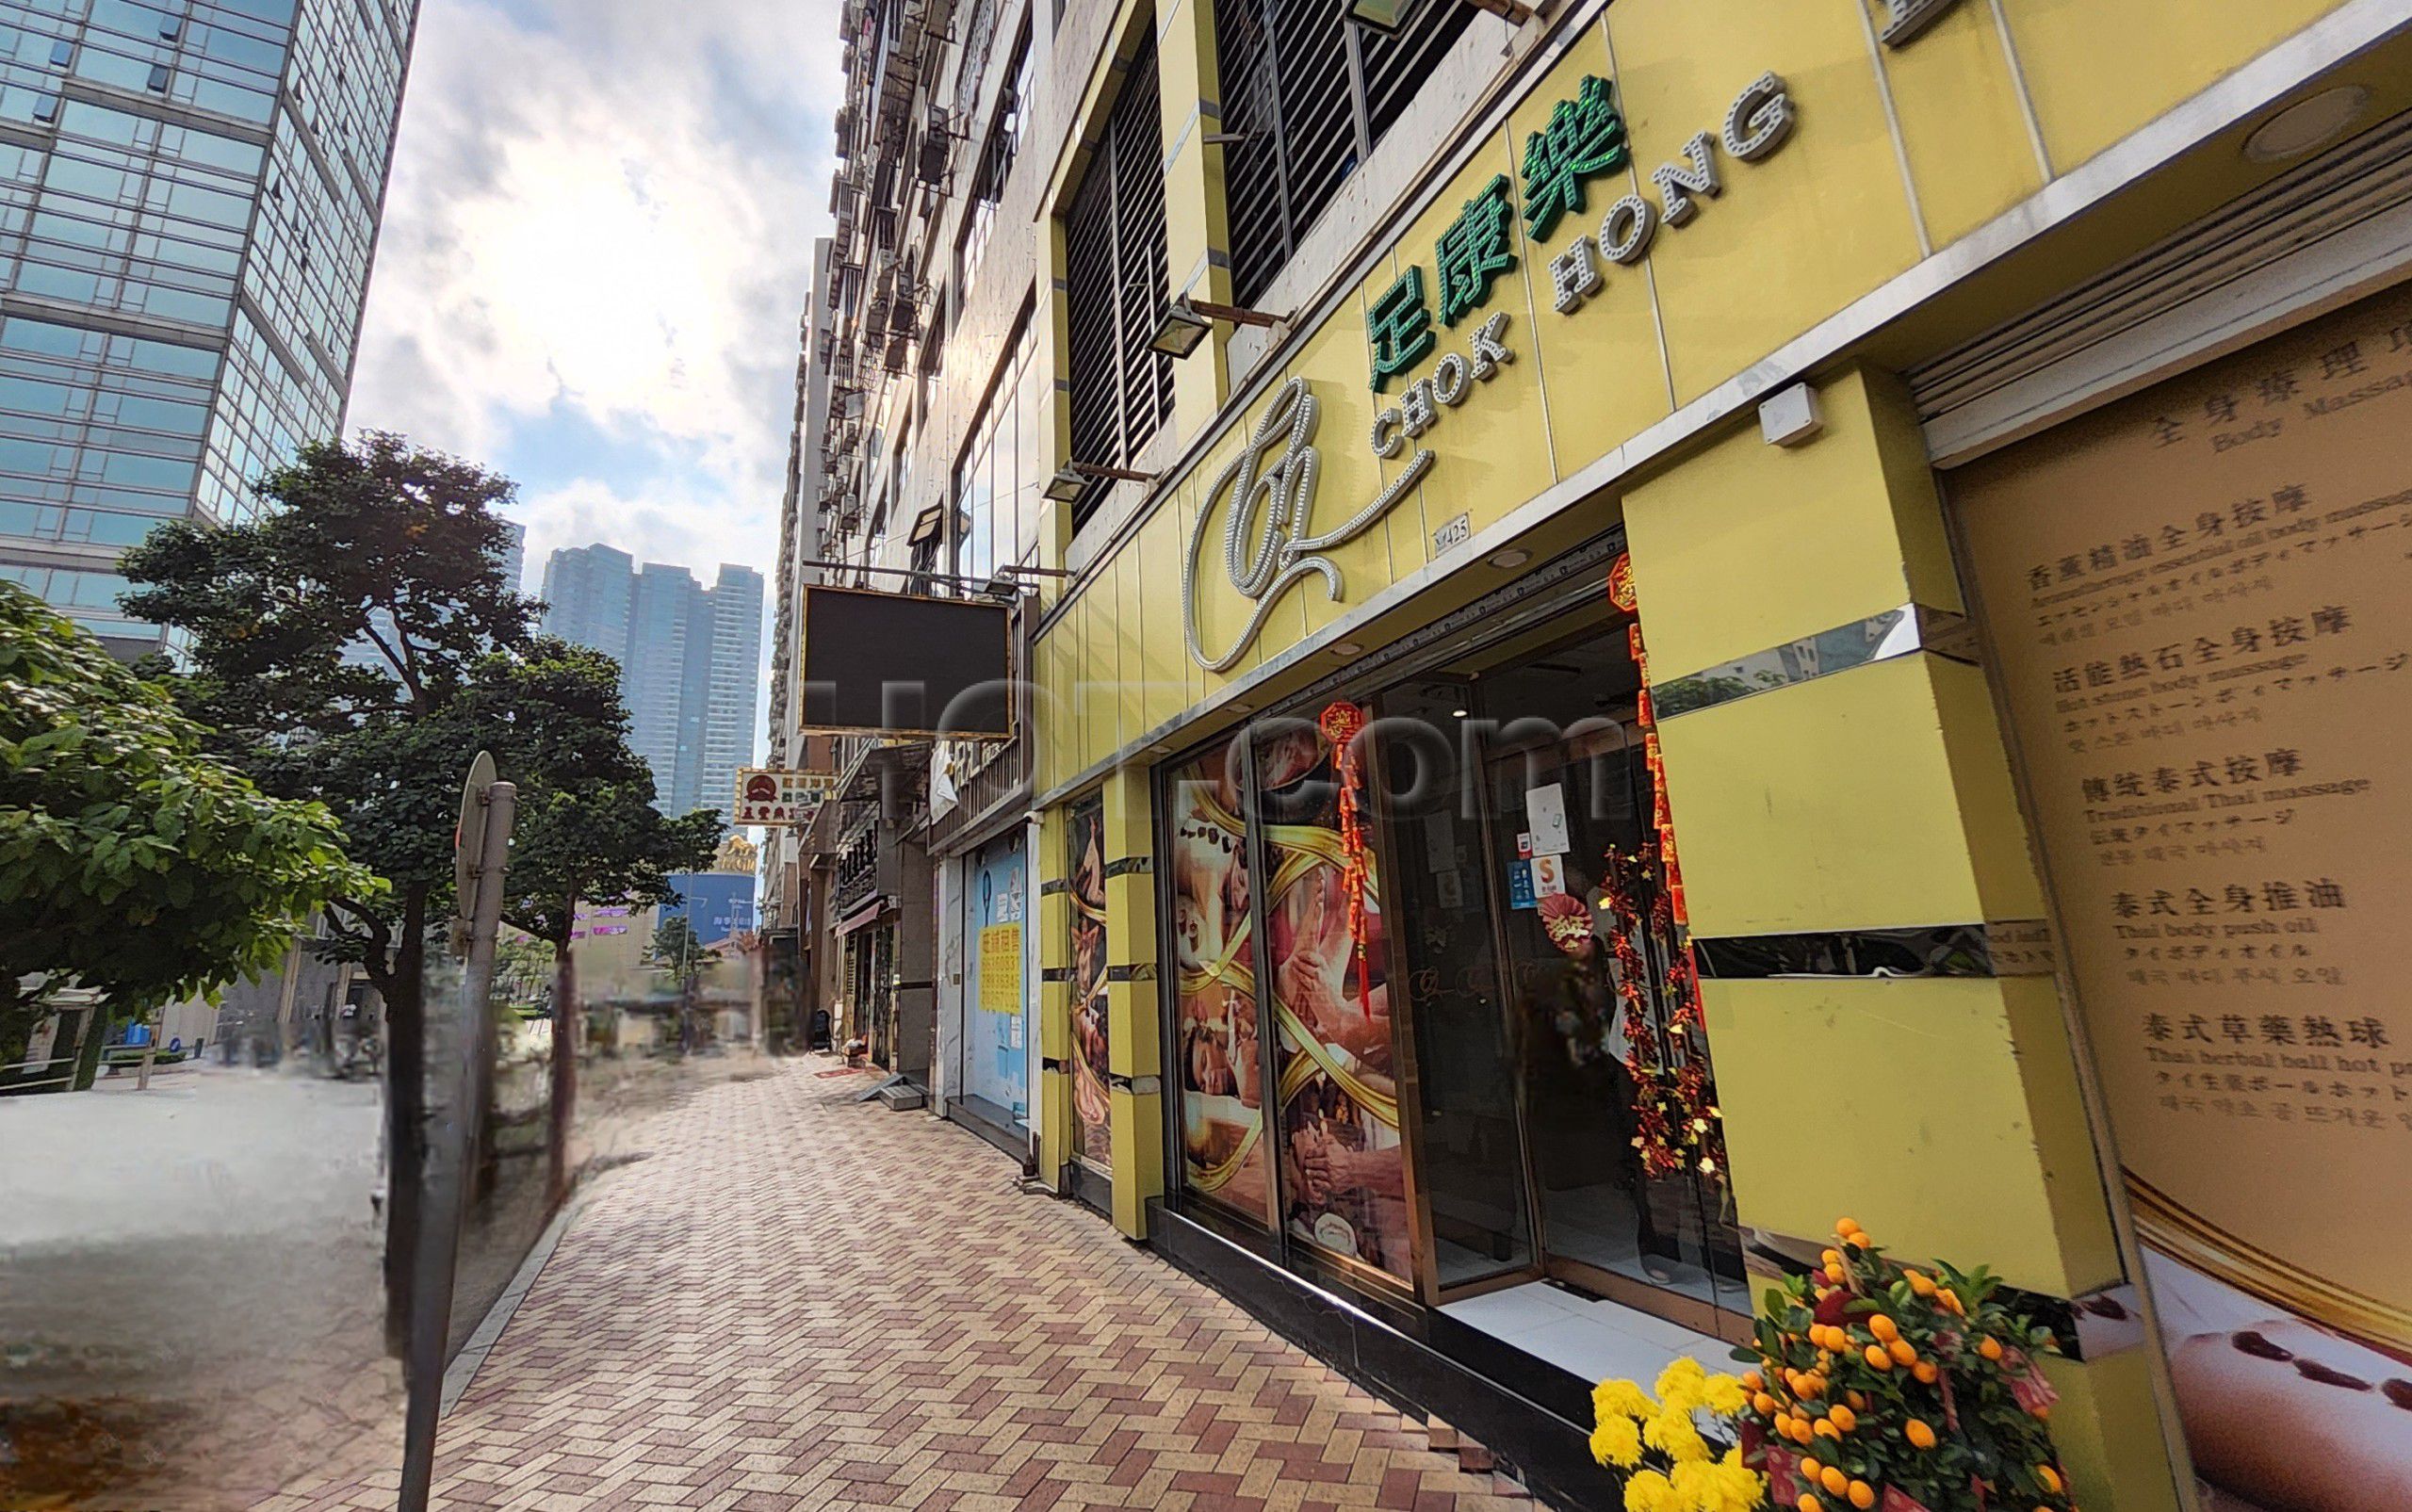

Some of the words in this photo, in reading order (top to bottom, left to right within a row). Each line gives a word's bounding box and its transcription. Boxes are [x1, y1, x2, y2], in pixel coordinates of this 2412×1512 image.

[1368, 73, 1630, 394] 足康樂
[1370, 311, 1514, 460] CHOK
[1548, 71, 1795, 316] HONG
[2110, 877, 2346, 919] 泰式全身推油
[2335, 1055, 2381, 1073] hot
